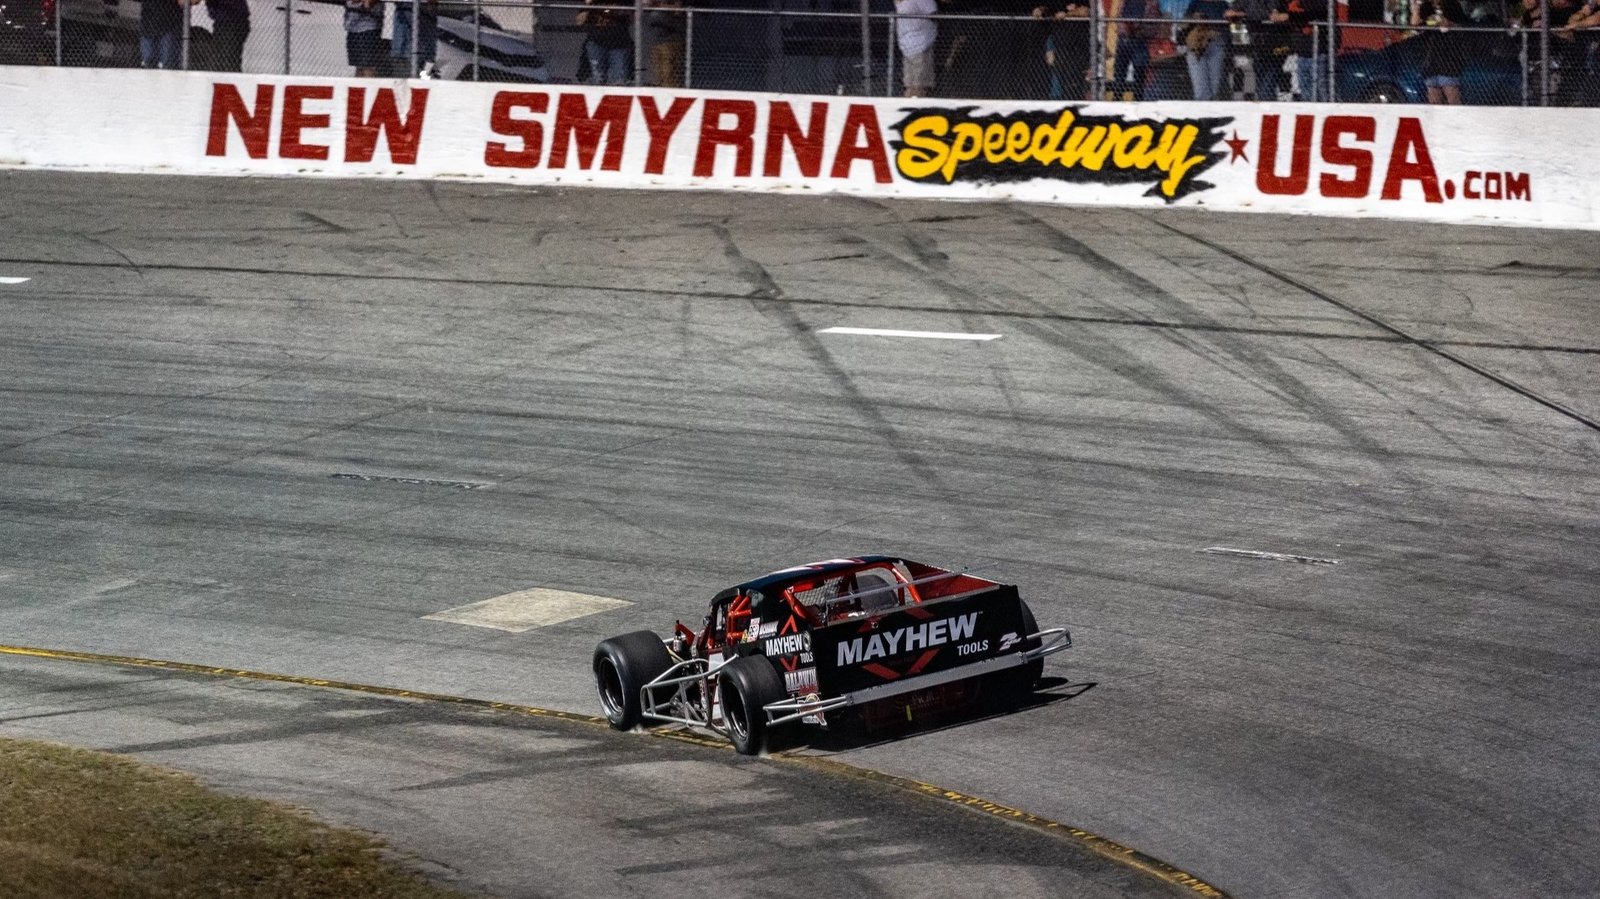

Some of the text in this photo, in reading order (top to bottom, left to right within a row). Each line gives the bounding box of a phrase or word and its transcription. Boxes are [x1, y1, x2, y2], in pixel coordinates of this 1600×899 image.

[205, 83, 430, 165] NEW
[484, 91, 892, 184] SMYRNA
[897, 110, 1206, 197] Speedway
[765, 633, 803, 657] MAYHEW
[837, 612, 978, 667] MAYHEW
[957, 640, 989, 657] TOOLS
[800, 652, 814, 664] TOOLS
[784, 668, 818, 692] BALDWIN
